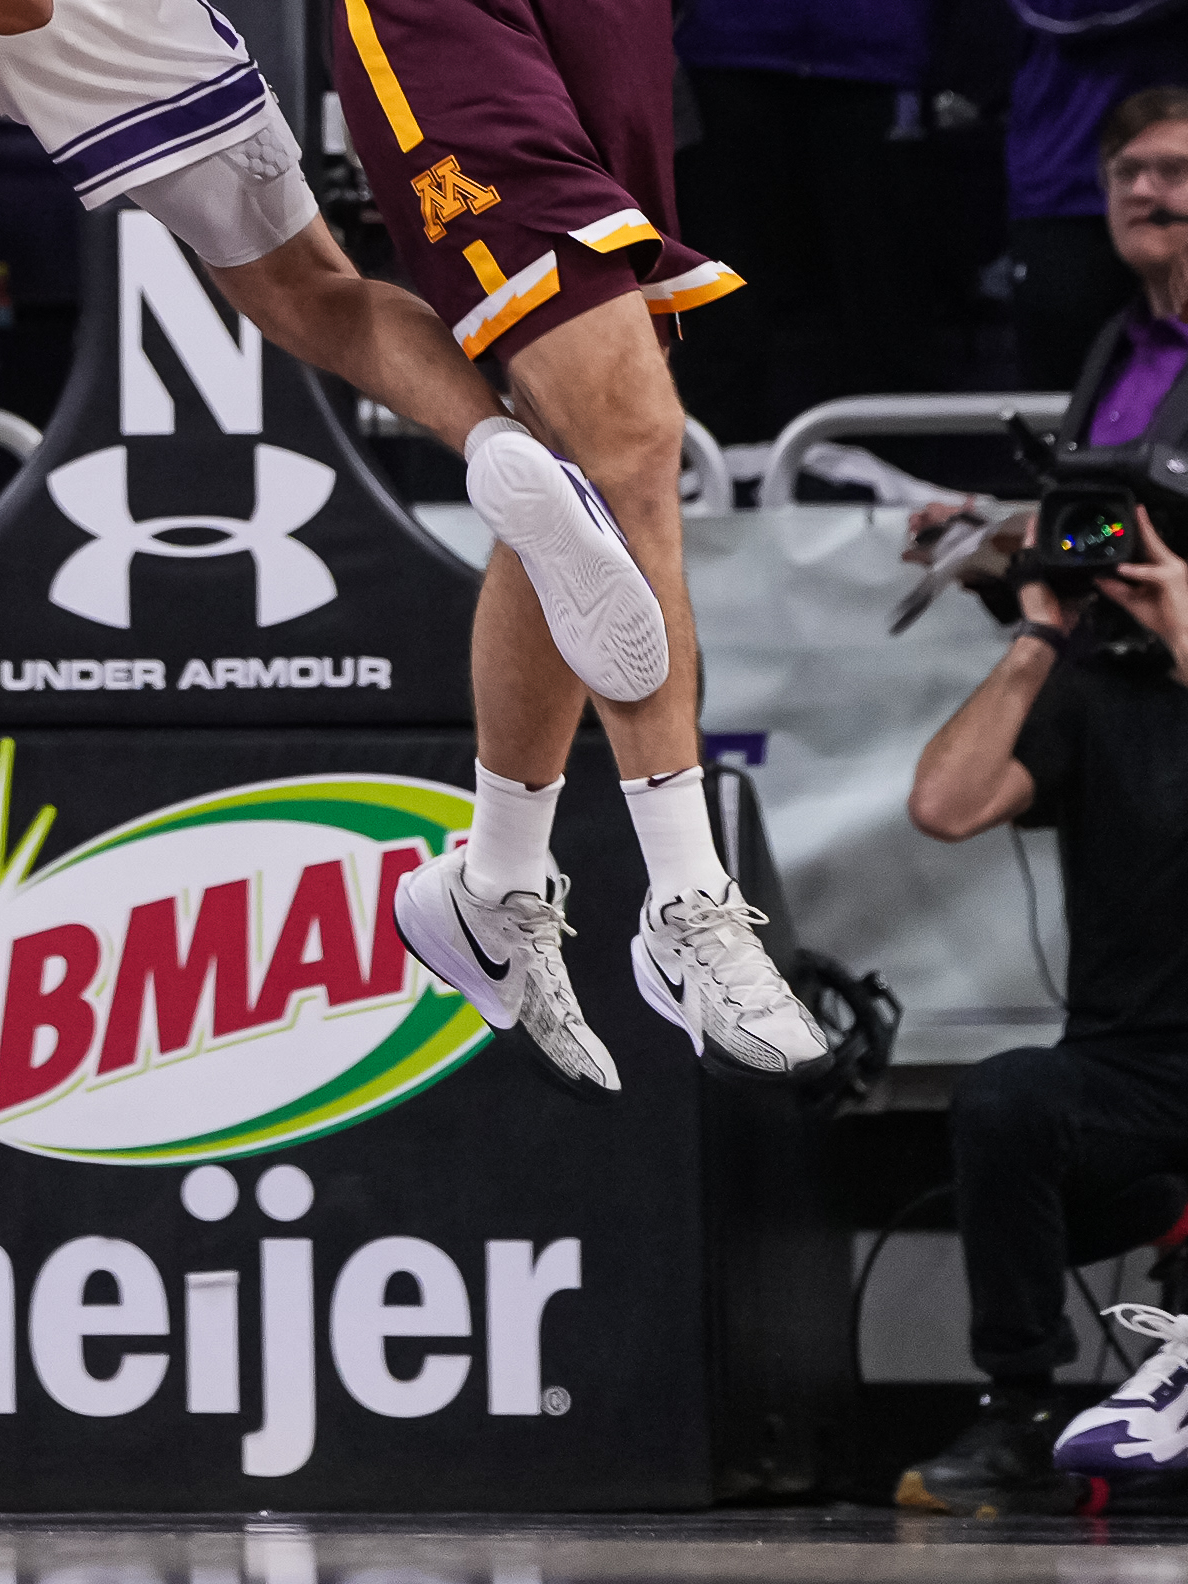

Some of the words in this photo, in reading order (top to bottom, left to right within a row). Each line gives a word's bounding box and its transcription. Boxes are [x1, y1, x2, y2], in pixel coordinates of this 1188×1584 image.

[410, 154, 502, 244] M
[118, 209, 264, 436] N
[0, 658, 166, 691] UNDER
[177, 656, 392, 690] ARMOUR
